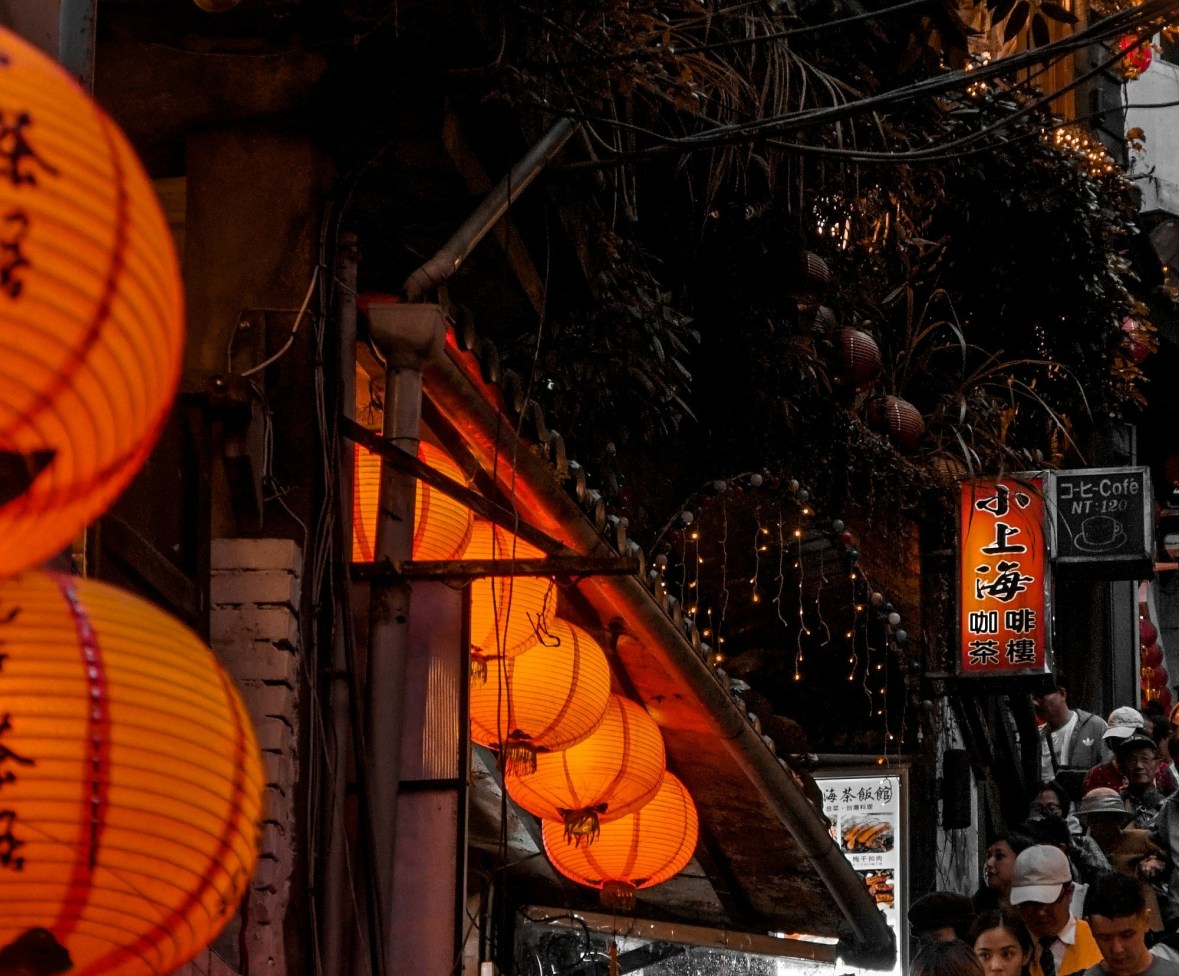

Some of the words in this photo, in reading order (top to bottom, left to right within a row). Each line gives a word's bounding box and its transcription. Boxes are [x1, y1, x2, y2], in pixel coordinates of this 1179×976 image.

[974, 484, 1035, 603] 小上海
[969, 608, 1037, 635] 咖啡
[969, 639, 1037, 665] 茶樓
